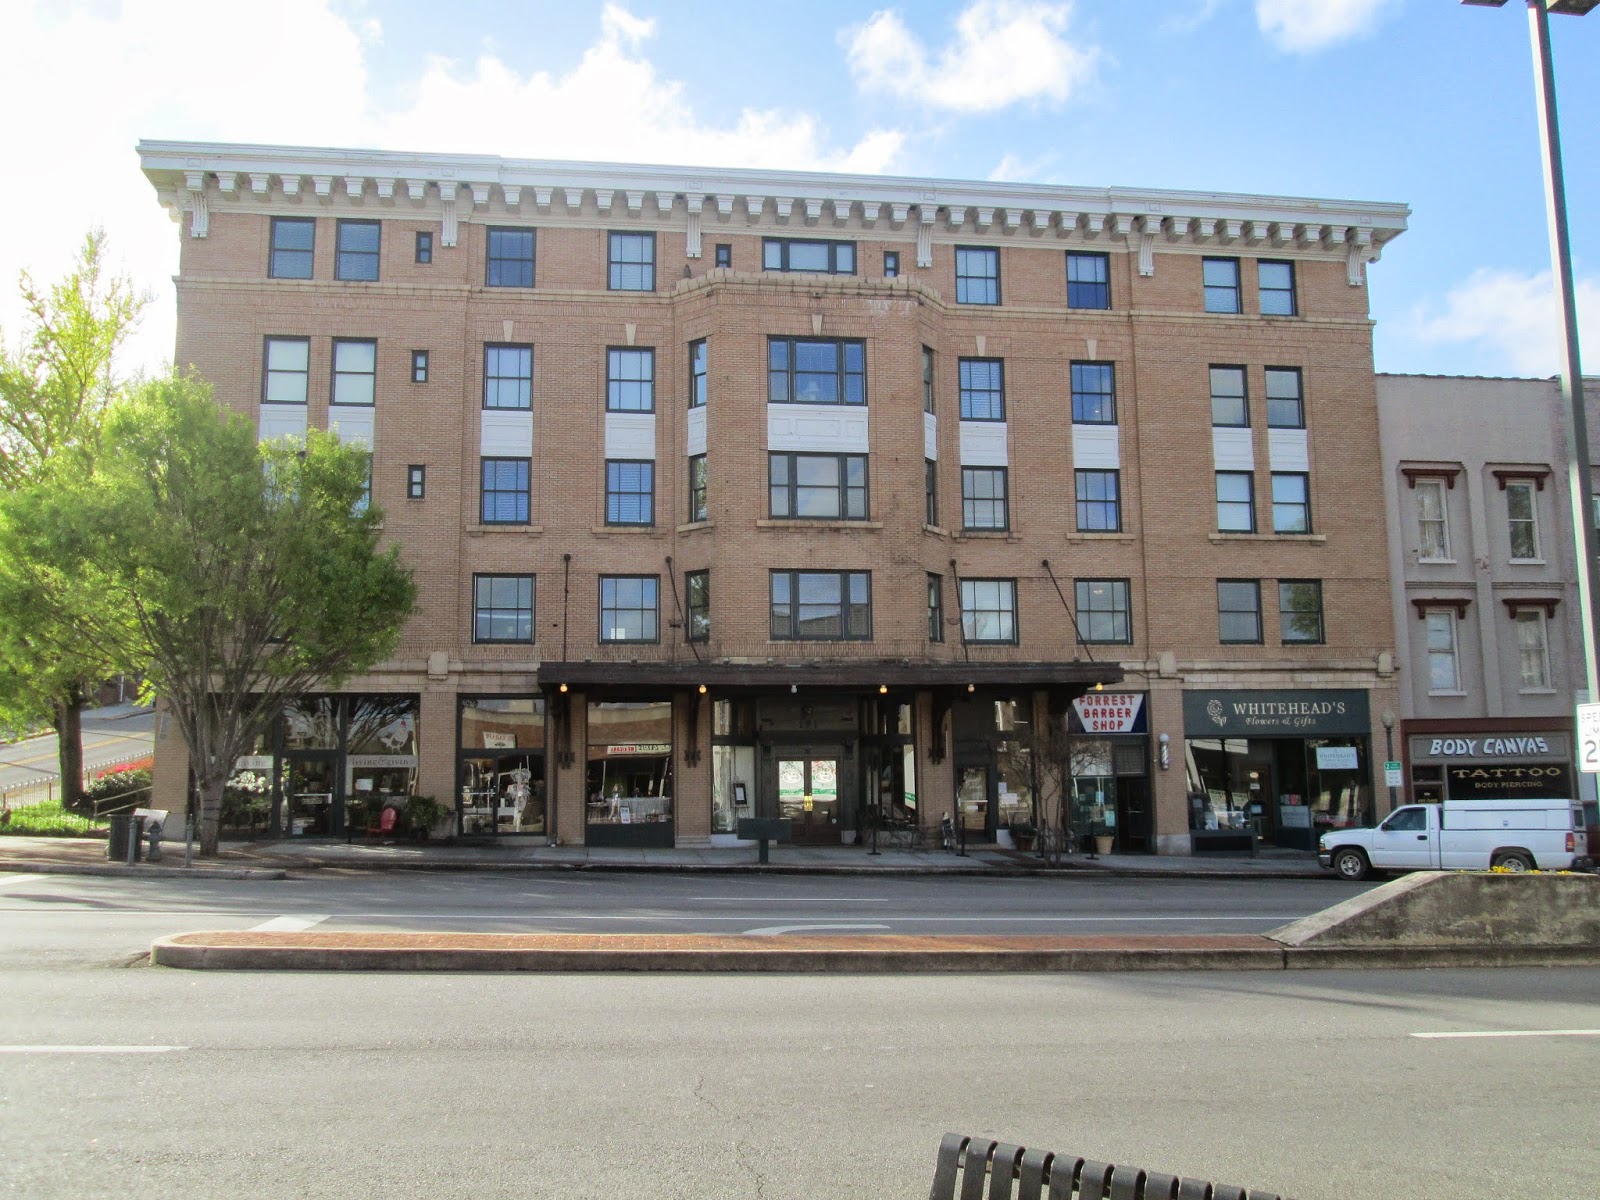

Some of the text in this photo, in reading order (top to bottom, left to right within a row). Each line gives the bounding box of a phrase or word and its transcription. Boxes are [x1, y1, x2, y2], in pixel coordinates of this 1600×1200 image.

[1079, 695, 1135, 706] FORREST
[1083, 708, 1132, 719] BARBER
[1232, 701, 1346, 715] WHITEHEAD'S
[1245, 716, 1280, 726] Flowers
[1293, 716, 1317, 727] Gifts
[1581, 711, 1600, 723] SPE
[1092, 720, 1124, 731] SHOP
[1429, 737, 1550, 756] BODY CANVAS
[1584, 739, 1600, 763] 2
[1452, 767, 1562, 779] TATTOO
